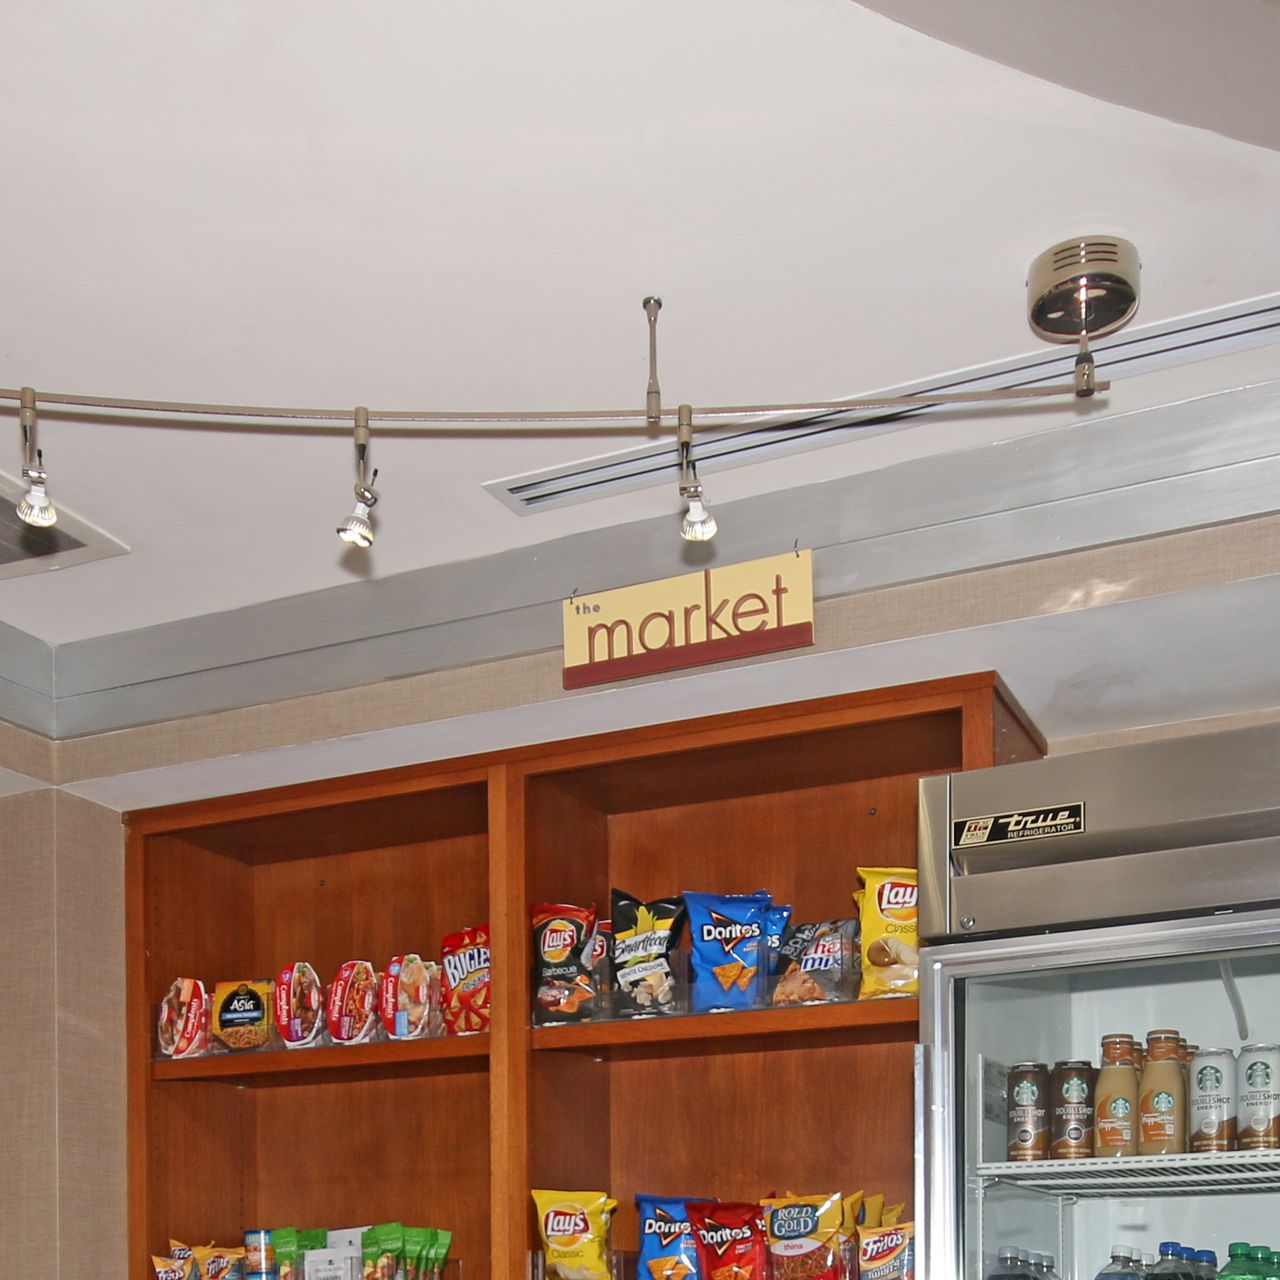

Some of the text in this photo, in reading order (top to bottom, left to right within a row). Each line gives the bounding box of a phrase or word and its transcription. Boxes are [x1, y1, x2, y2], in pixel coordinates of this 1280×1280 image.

[575, 602, 601, 615] the
[588, 568, 789, 664] market
[998, 810, 1075, 831] true
[1007, 823, 1075, 839] REFRIGERATOR
[881, 883, 918, 909] Lay
[703, 923, 761, 941] Doritos
[442, 947, 490, 990] BUGLE
[229, 999, 255, 1011] Asia
[547, 1210, 586, 1236] Lay's
[778, 1207, 812, 1220] ROLD
[644, 1218, 691, 1235] Dorito
[699, 1225, 752, 1246] Doritos
[773, 1217, 812, 1236] GOLD
[552, 1249, 584, 1258] Classic
[862, 1231, 904, 1260] Fritos
